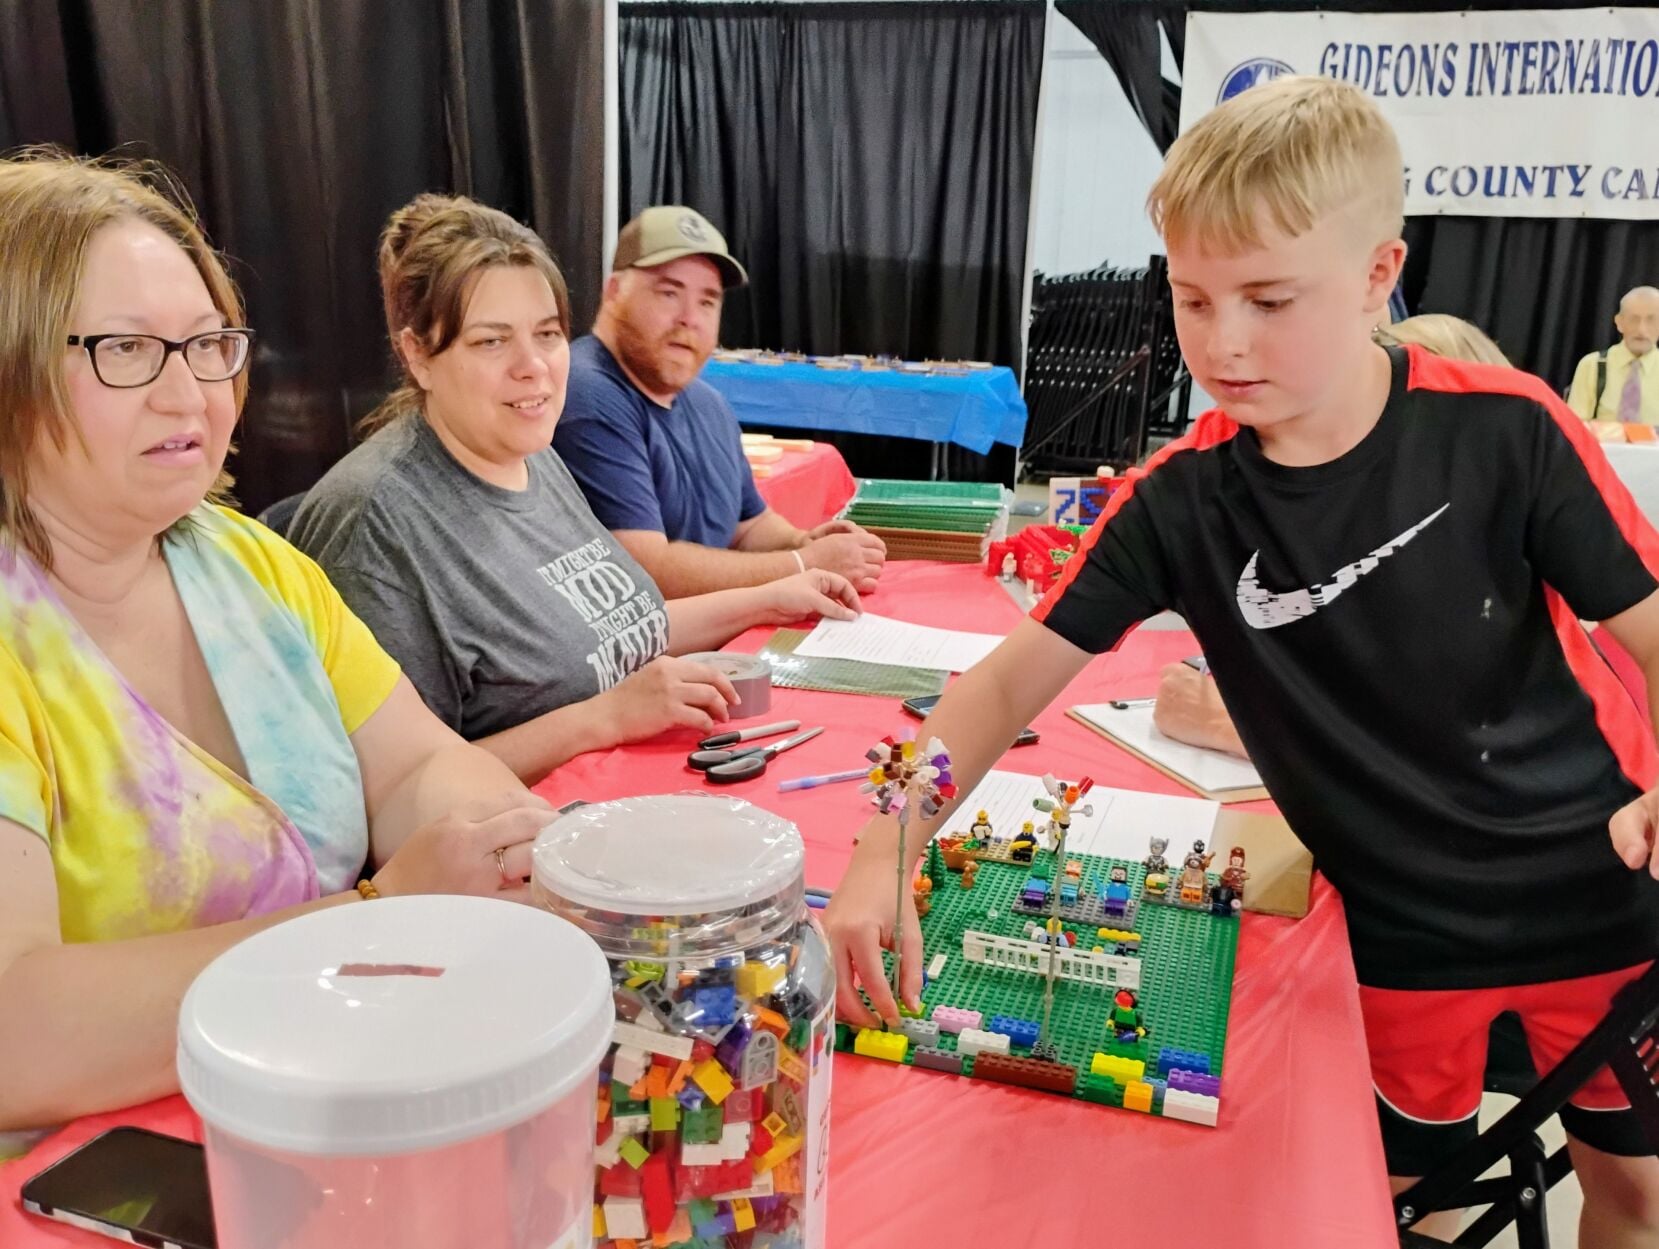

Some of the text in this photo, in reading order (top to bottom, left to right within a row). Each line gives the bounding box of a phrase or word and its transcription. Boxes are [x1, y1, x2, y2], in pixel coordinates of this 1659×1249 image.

[1319, 37, 1659, 98] GIDEONS INTERNATIO
[1425, 165, 1592, 198] COUNTY
[1601, 166, 1659, 200] CA
[547, 546, 595, 583] MIGHT
[585, 537, 612, 561] BE
[634, 591, 657, 615] BE
